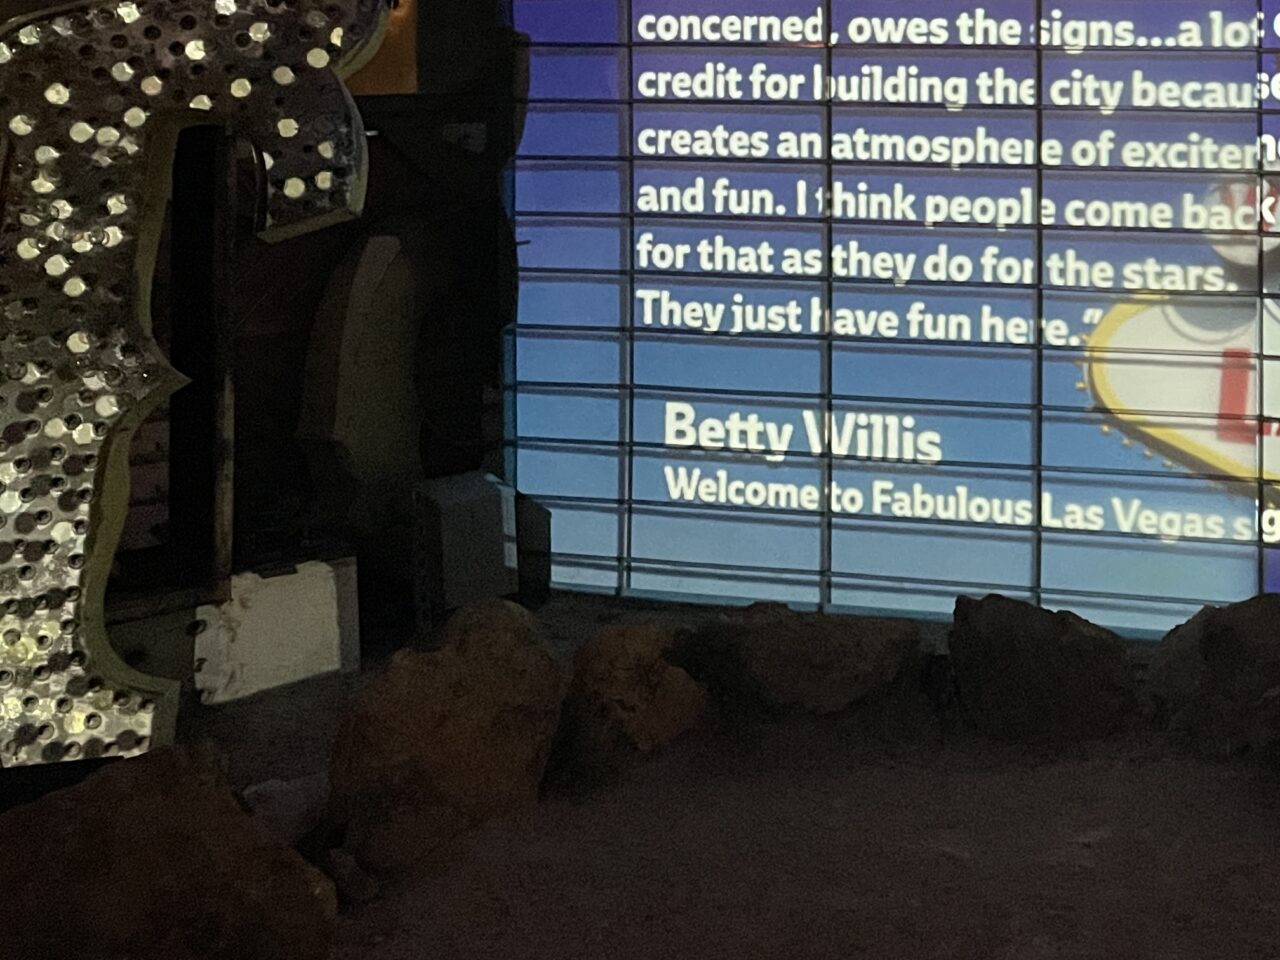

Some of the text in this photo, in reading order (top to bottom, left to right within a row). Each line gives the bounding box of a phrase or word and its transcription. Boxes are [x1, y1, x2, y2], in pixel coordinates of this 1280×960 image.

[638, 7, 839, 47] concerned,
[848, 17, 948, 43] owes
[957, 8, 1022, 45] the
[1210, 11, 1264, 48] lot
[638, 63, 742, 100] credit
[750, 64, 805, 99] for
[814, 64, 968, 111] building
[976, 68, 1035, 105] the
[1050, 69, 1123, 114] city
[638, 125, 769, 157] creates
[778, 131, 822, 158] an
[831, 126, 1061, 171] atmosphere
[1072, 130, 1115, 167] of
[637, 177, 704, 213] and
[712, 179, 786, 215] fun.
[797, 180, 806, 215] I
[816, 181, 916, 219] think
[926, 188, 1055, 231] people
[1064, 200, 1173, 228] come
[1183, 186, 1273, 230] back
[637, 234, 1238, 292] for that as they do for the stars.
[636, 290, 724, 333] They
[730, 294, 802, 335] just
[811, 297, 899, 337] have
[906, 302, 971, 340] fun
[664, 401, 942, 464] Betty Willis
[664, 465, 819, 511] Welcome
[832, 481, 863, 513] to
[872, 480, 1033, 526] Fabulous
[1041, 492, 1104, 529] Las
[1111, 496, 1223, 543] Vegas
